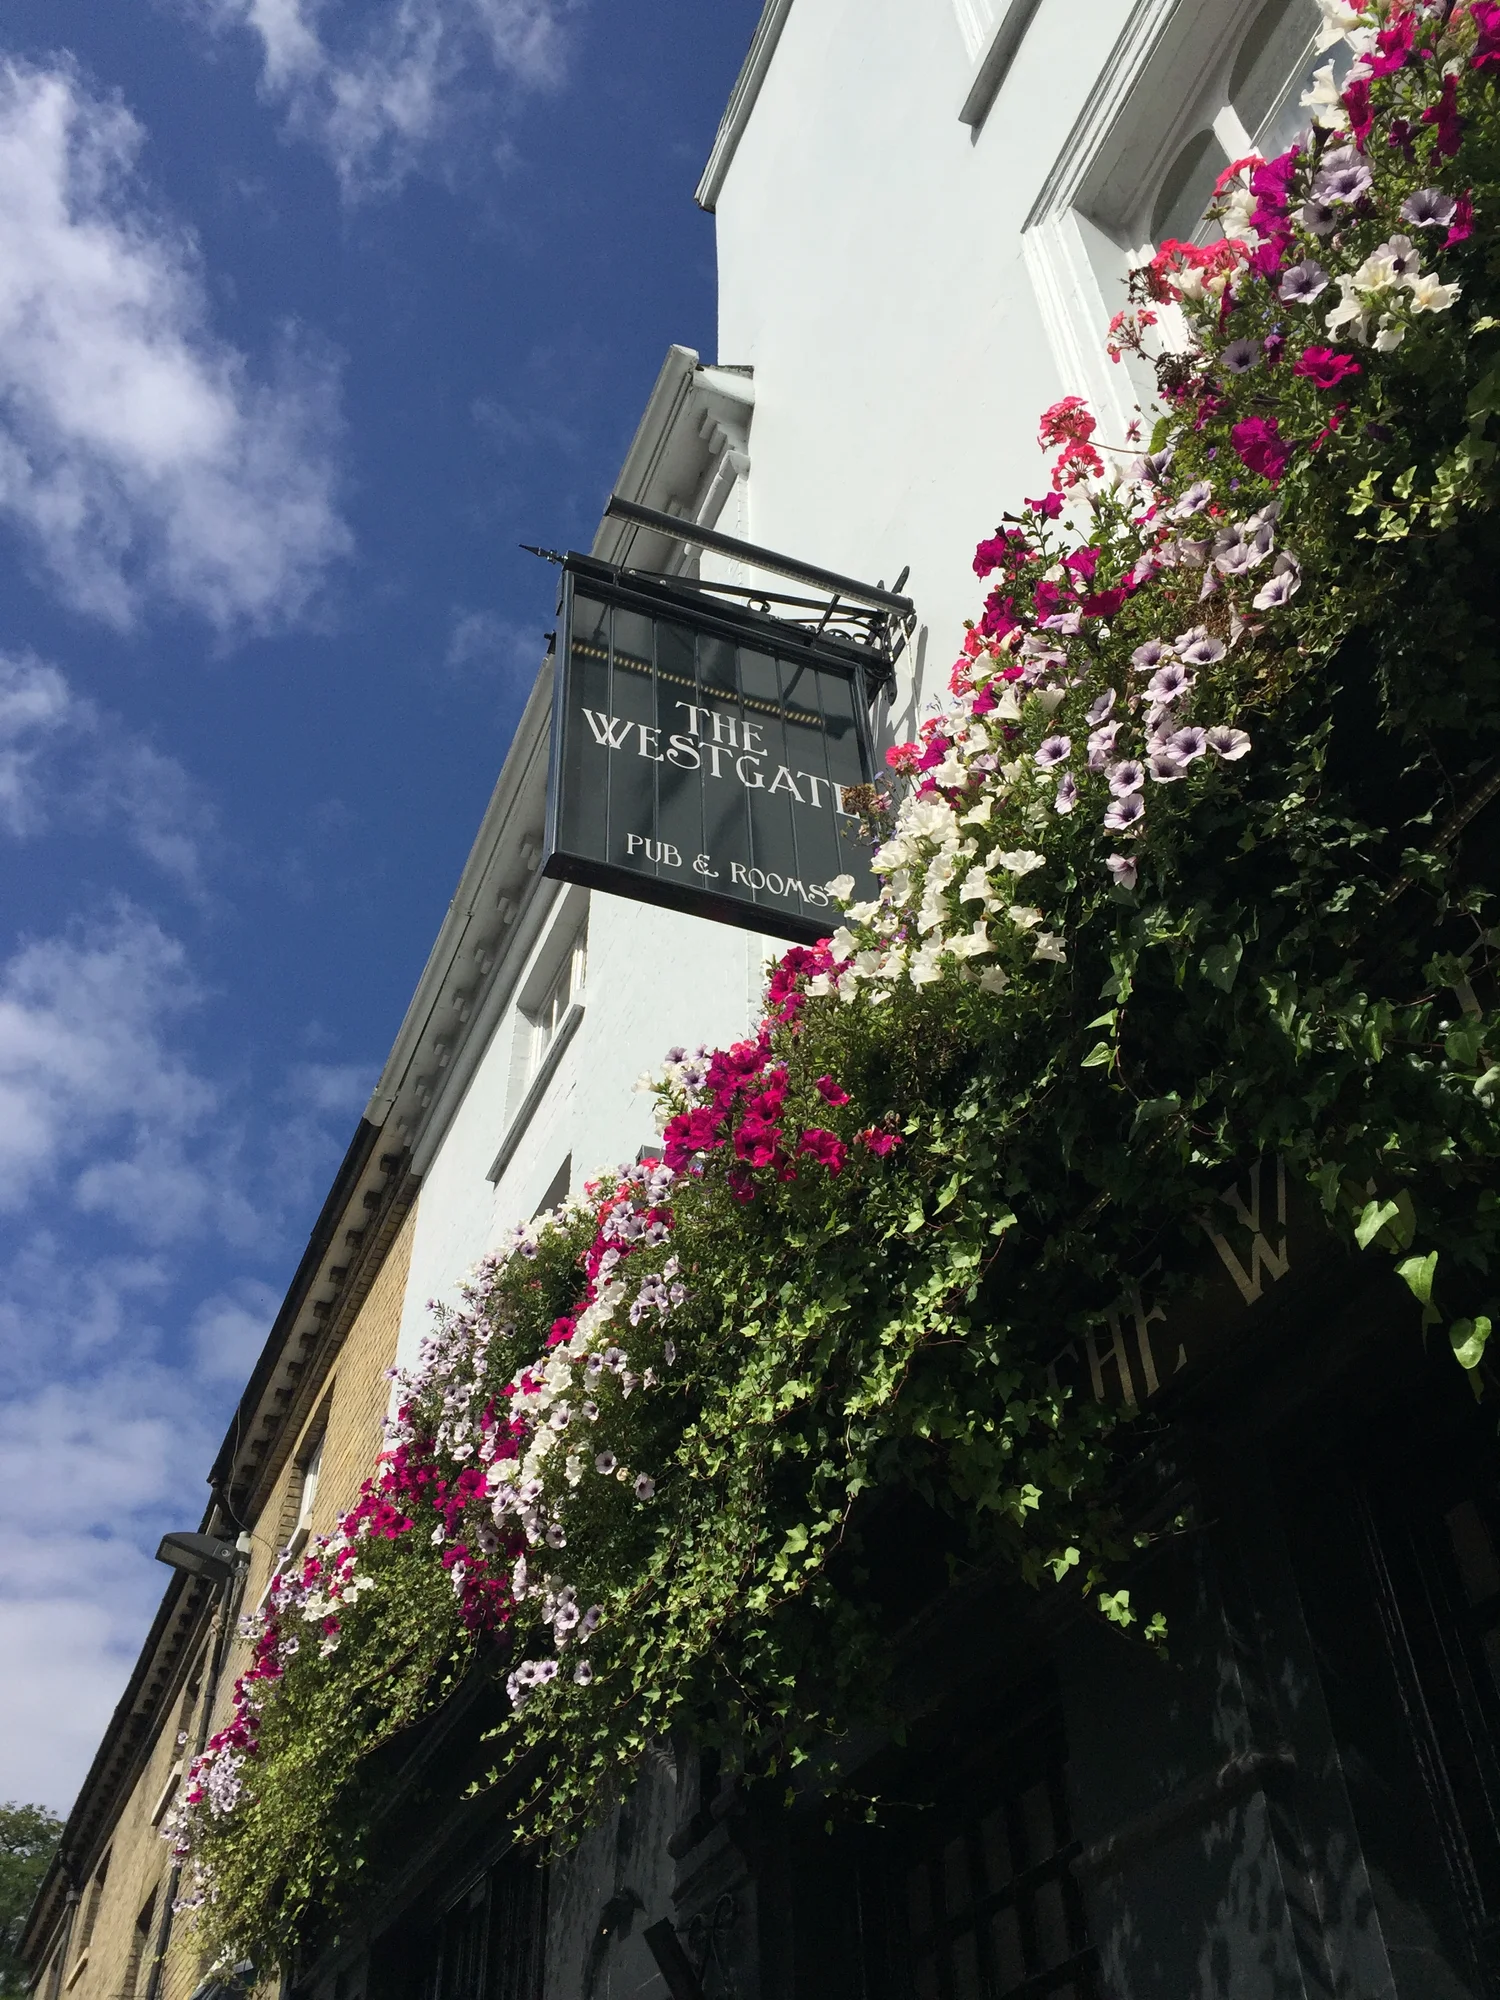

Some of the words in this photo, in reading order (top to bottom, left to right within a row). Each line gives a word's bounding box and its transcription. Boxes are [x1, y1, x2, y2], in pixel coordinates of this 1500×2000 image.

[675, 701, 768, 756] THE
[626, 833, 683, 867] PUB
[692, 854, 720, 878] &
[730, 862, 830, 907] ROOMS
